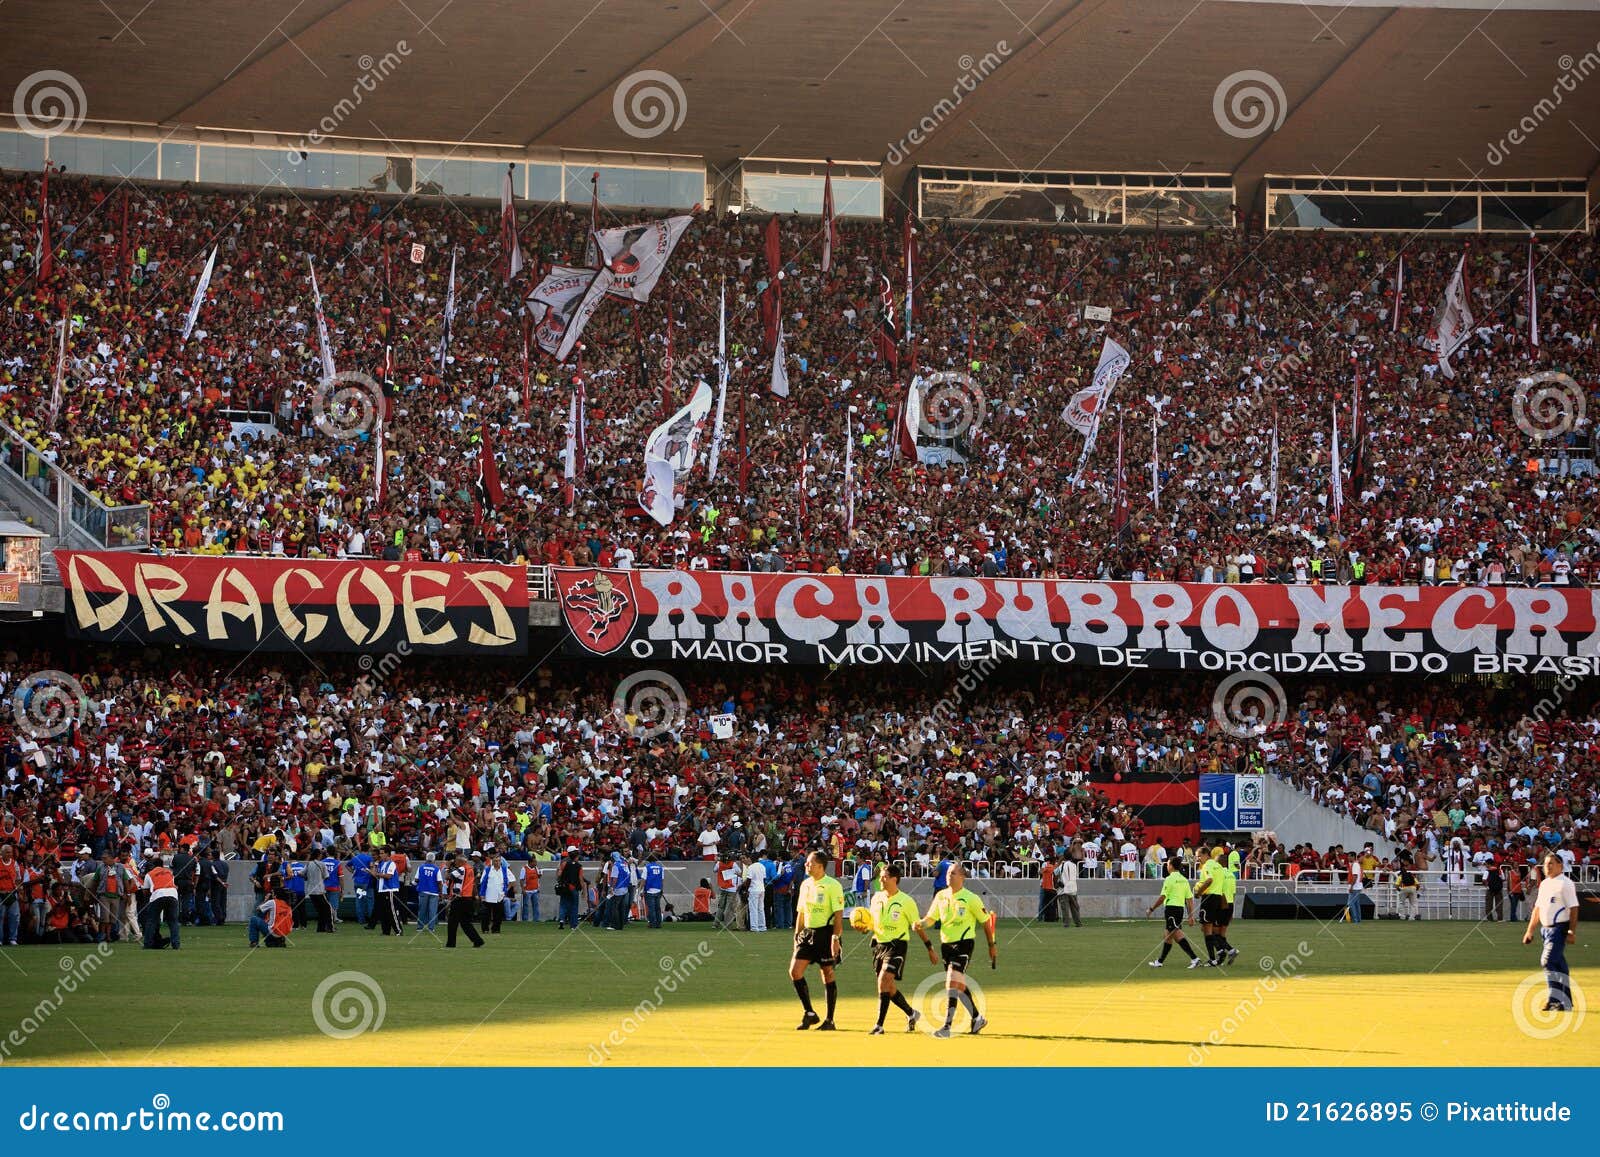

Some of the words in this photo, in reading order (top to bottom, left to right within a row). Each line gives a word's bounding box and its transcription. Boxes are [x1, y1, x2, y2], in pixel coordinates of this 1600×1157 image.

[630, 639, 654, 659] O
[671, 640, 788, 663] MAIOR
[818, 639, 1075, 664] MOVIMENTO
[1097, 646, 1149, 668] DE
[1168, 648, 1366, 672] TORCIDAS
[1390, 652, 1448, 673] DO
[1200, 792, 1228, 812] EU
[1087, 849, 1096, 859] 10
